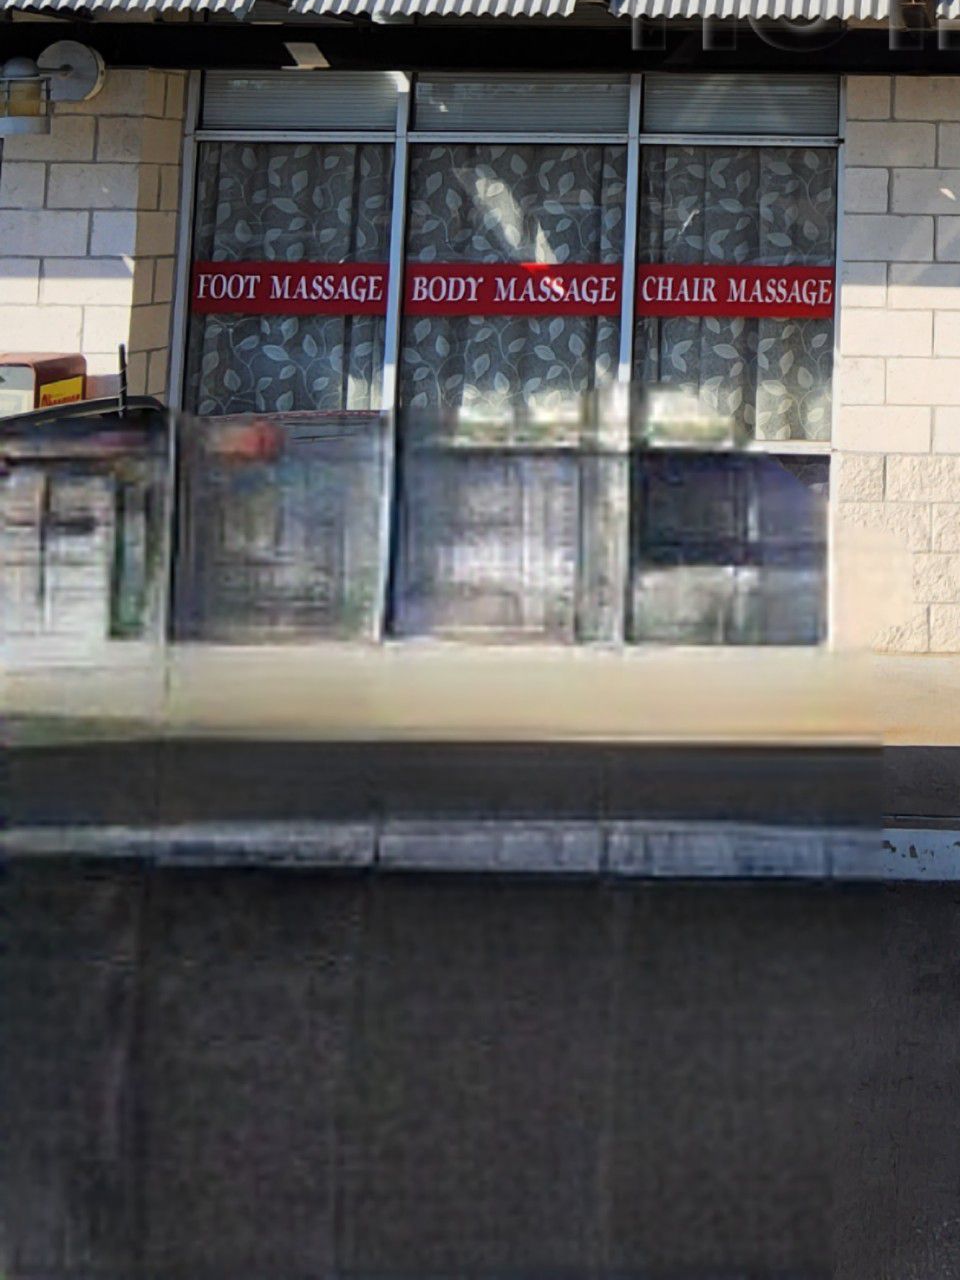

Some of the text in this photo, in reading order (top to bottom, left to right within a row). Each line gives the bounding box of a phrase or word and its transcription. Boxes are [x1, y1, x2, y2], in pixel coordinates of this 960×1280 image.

[196, 273, 383, 303] FOOT MASSAGE
[411, 275, 616, 305] BODY MASSAGE
[641, 277, 832, 306] CHAIR MASSAGE
